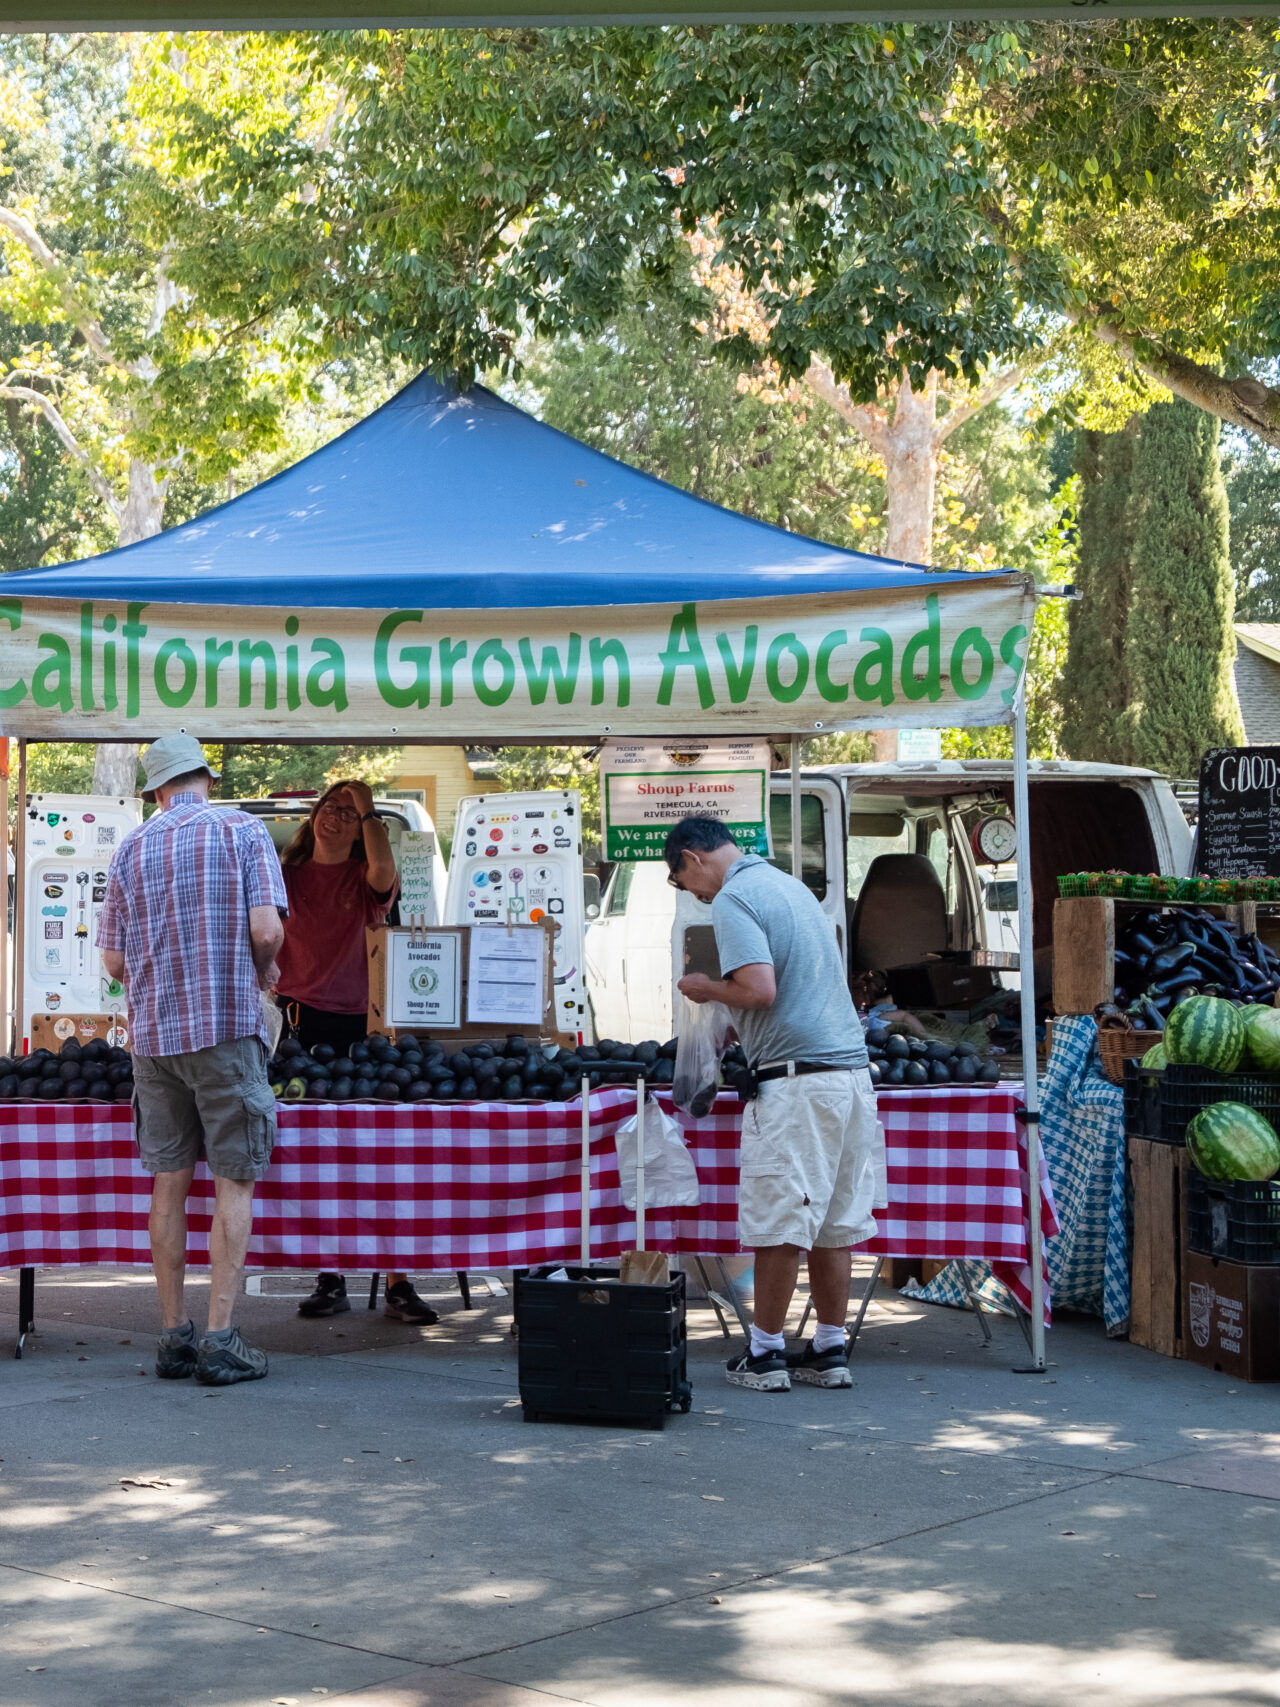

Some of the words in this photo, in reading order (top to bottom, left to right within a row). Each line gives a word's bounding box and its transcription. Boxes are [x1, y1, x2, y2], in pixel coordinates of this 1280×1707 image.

[374, 609, 631, 710] Grown
[656, 591, 1028, 711] Avocados
[637, 783, 685, 797] Shoup
[688, 782, 735, 794] Farms
[656, 801, 704, 809] TEMECULA,
[644, 809, 691, 818] RIVERSIDE
[695, 809, 730, 817] COUNTY
[617, 830, 641, 841] We
[645, 830, 668, 840] are
[614, 846, 628, 858] of
[633, 845, 665, 857] wha
[407, 941, 442, 950] California
[407, 952, 441, 961] Avocados
[406, 1001, 424, 1009] Shoup
[425, 1001, 440, 1009] Farm
